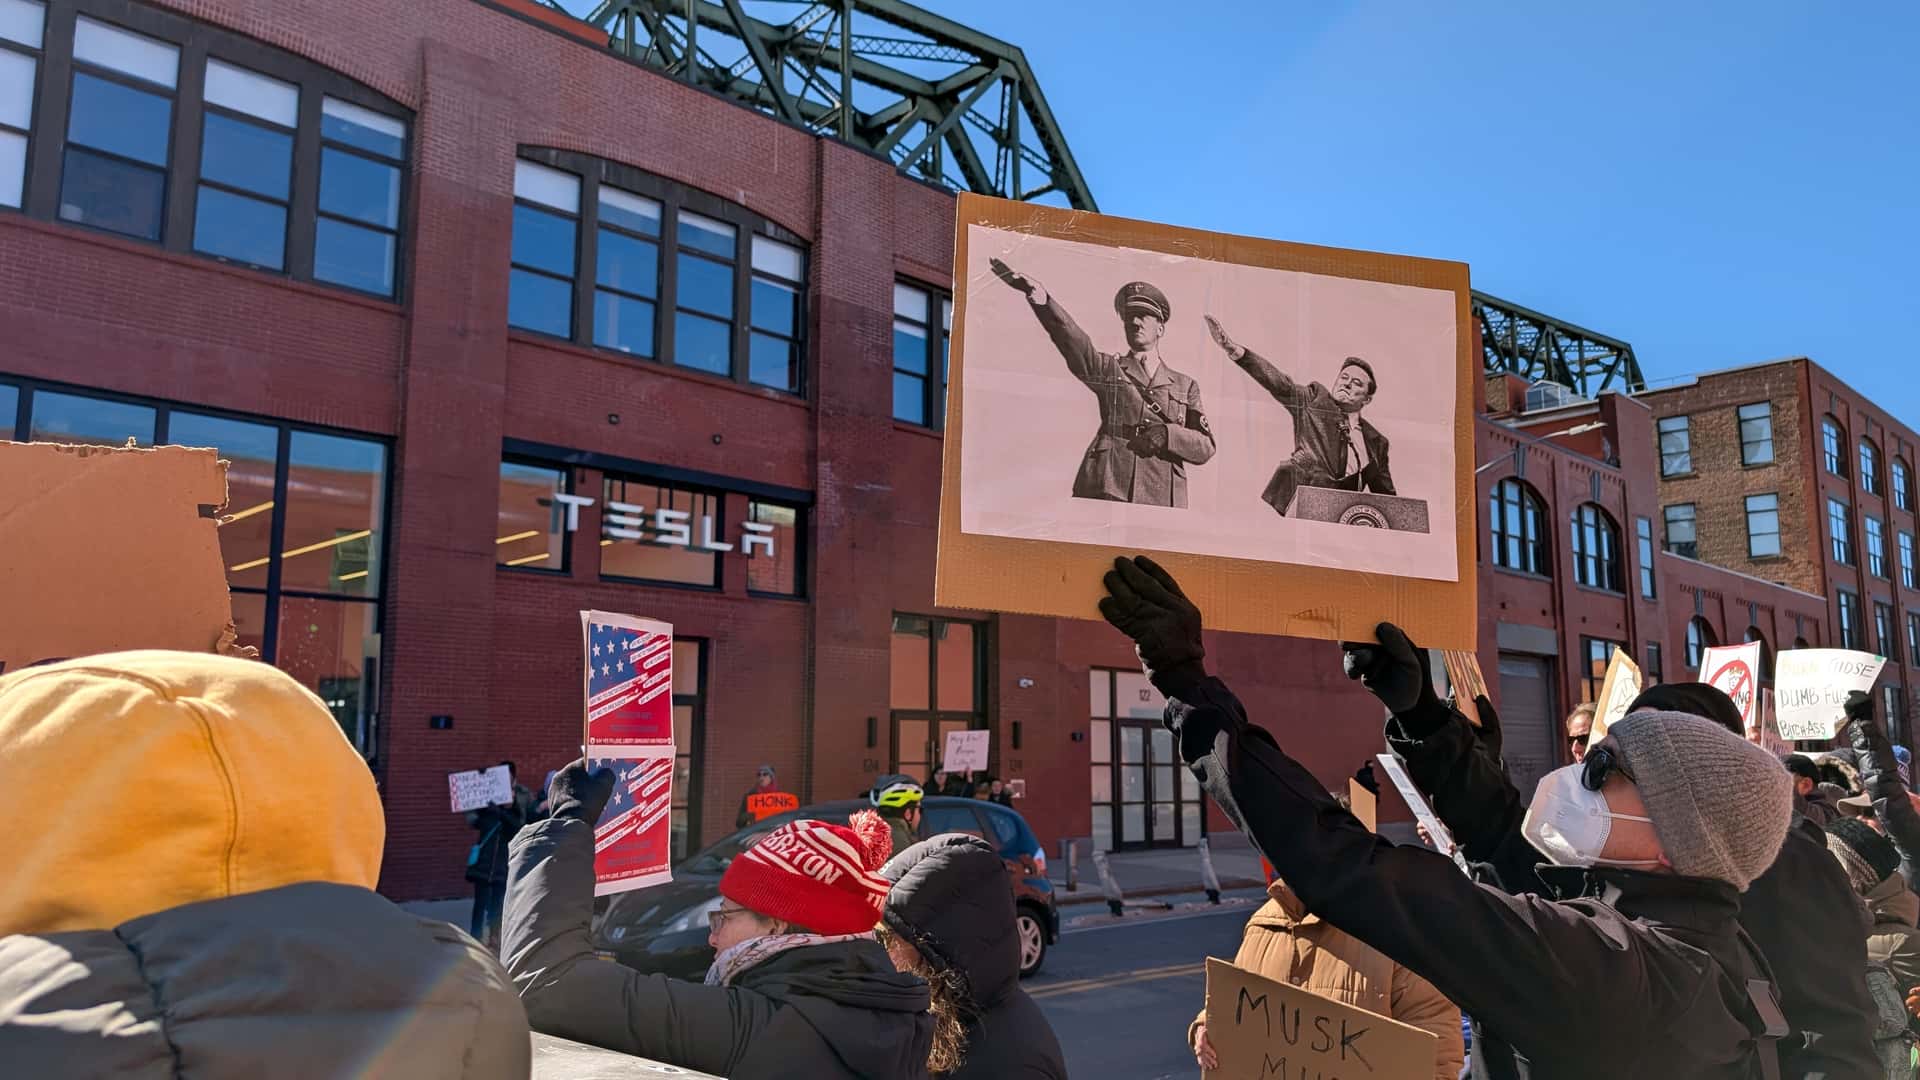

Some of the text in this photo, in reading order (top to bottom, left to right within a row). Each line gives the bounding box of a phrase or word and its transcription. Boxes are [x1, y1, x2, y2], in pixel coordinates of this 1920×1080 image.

[554, 493, 775, 558] TESLA
[1779, 688, 1819, 708] DUMB
[754, 794, 793, 808] HONK
[1235, 986, 1374, 1073] MUSK
